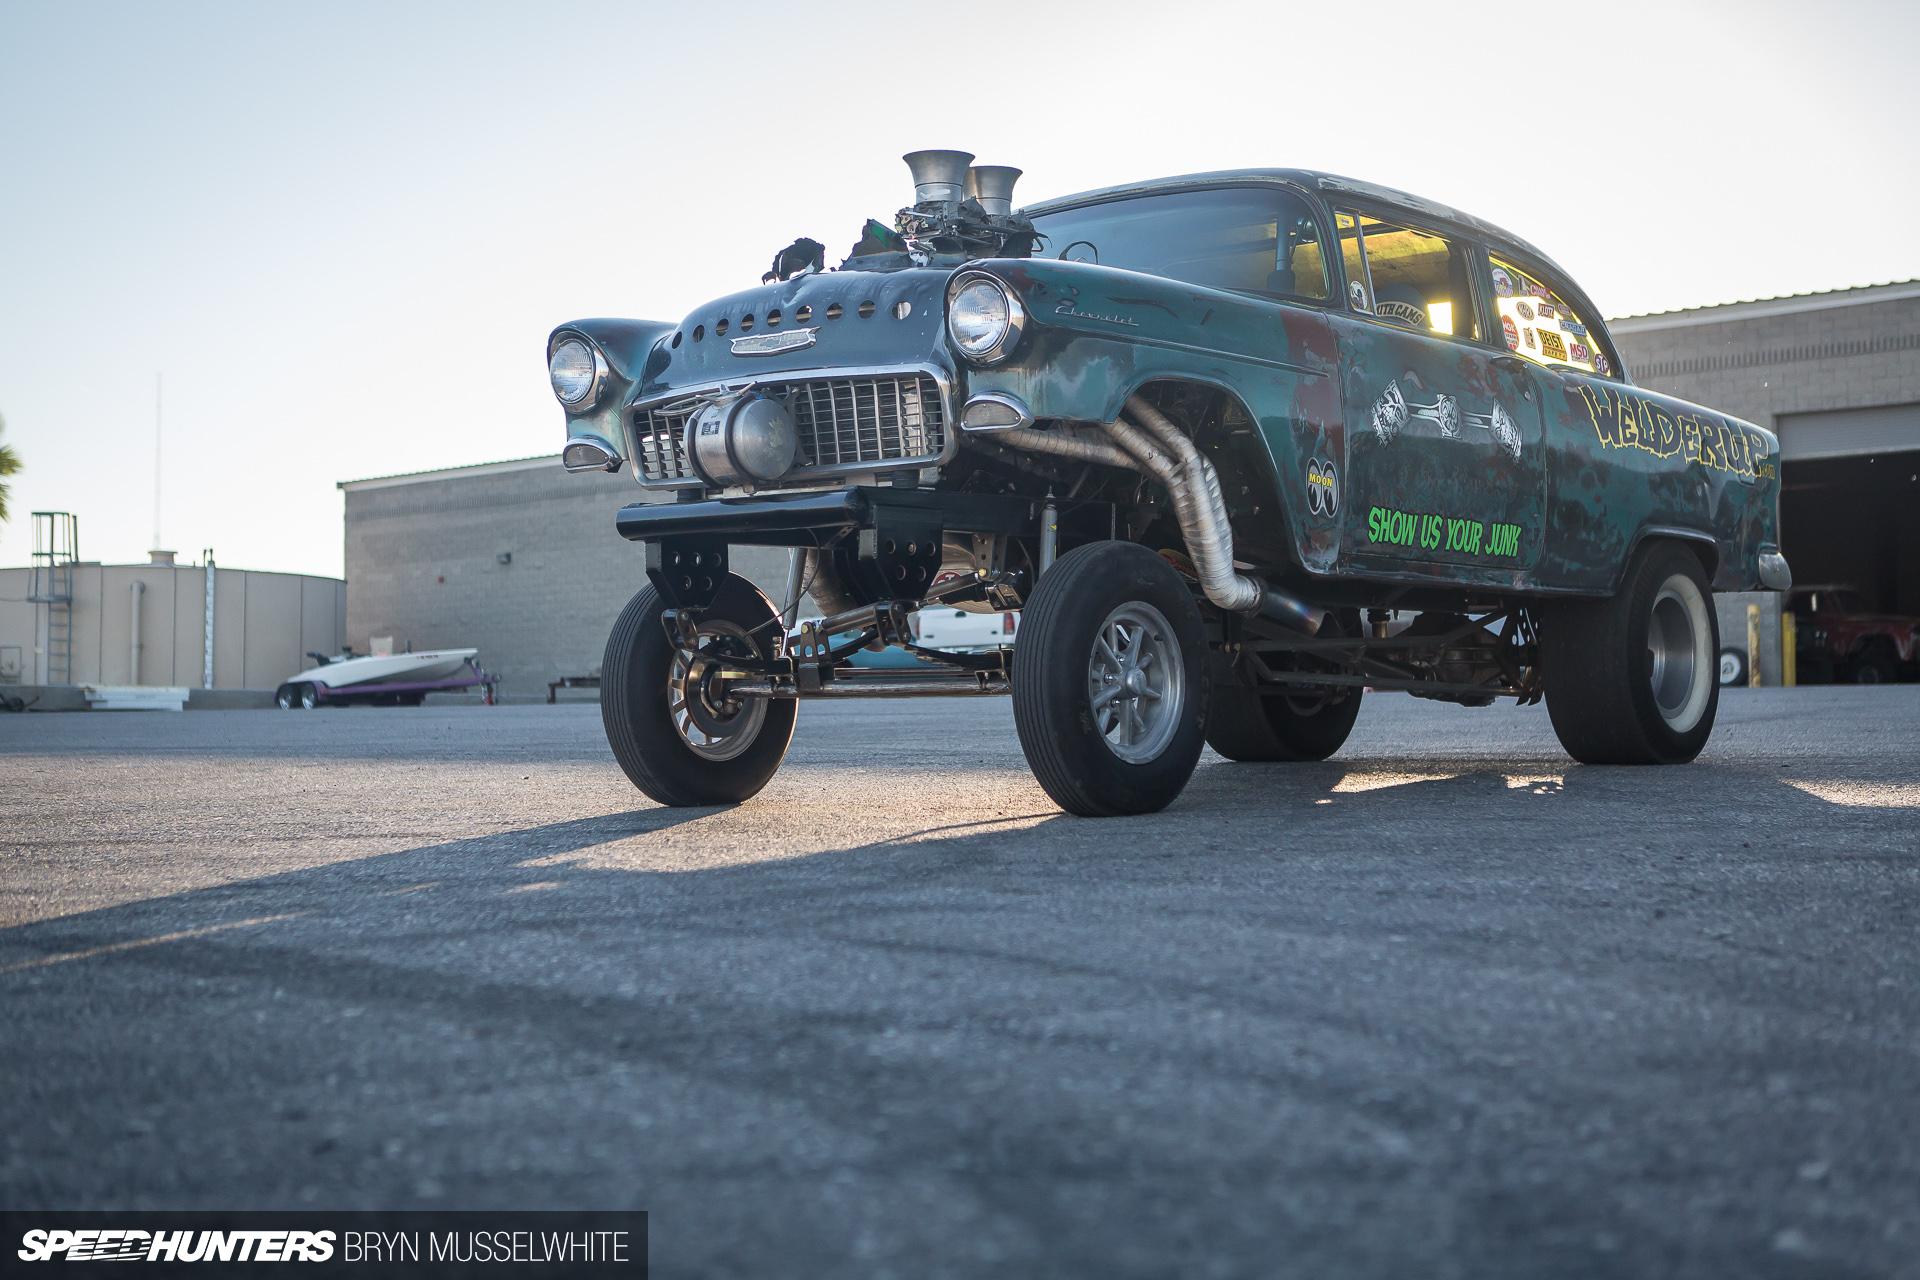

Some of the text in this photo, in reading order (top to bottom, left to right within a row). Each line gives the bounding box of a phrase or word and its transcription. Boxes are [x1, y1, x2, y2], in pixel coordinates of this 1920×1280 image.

[1055, 305, 1139, 327] Chevrolet
[1394, 304, 1422, 324] CAMS
[1569, 343, 1588, 358] MSD
[1595, 354, 1609, 373] STP
[1578, 384, 1769, 478] WELDERUP
[1309, 472, 1333, 488] MOON
[1368, 506, 1522, 557] SHOW US YOUR JUNK
